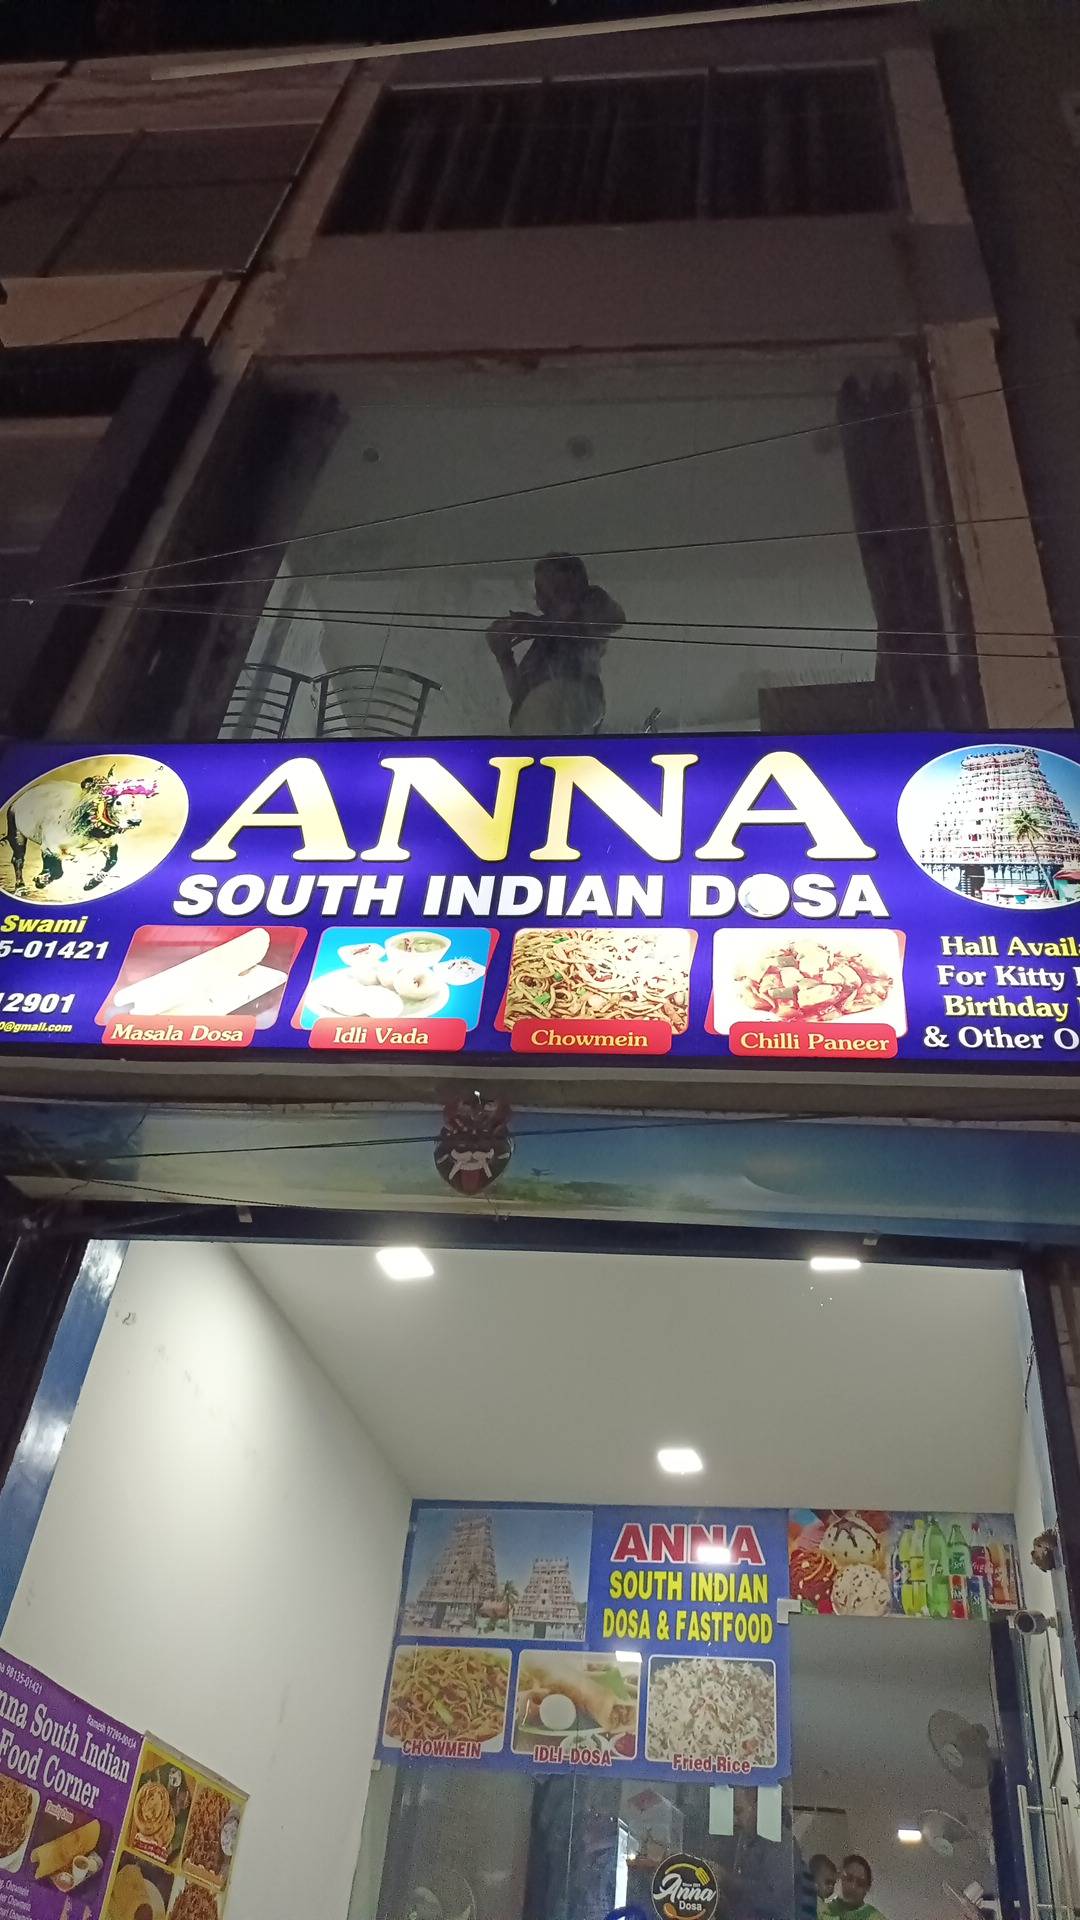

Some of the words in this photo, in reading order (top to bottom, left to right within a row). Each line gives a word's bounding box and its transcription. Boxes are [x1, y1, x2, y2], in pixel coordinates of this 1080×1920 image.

[190, 751, 878, 862] ANNA
[173, 873, 406, 918] SOUTH
[424, 873, 664, 919] INDIAN
[690, 873, 891, 919] DOSA
[0, 915, 88, 933] Swami
[940, 936, 999, 956] Hall
[937, 965, 987, 986] For
[994, 966, 1065, 991] Kitty
[944, 995, 1069, 1022] Birthday
[110, 1024, 184, 1042] Masala
[188, 1025, 244, 1043] Dosa
[333, 1026, 371, 1044] Idli
[374, 1027, 429, 1045] Vada
[530, 1029, 649, 1048] Chowmein
[740, 1032, 800, 1050] Chilli
[808, 1034, 890, 1052] Paneer
[923, 1026, 950, 1048] &
[958, 1026, 1044, 1049] Other
[611, 1522, 766, 1566] ANNA
[609, 1570, 683, 1602] SOUTH
[690, 1572, 769, 1604] INDIAN
[602, 1607, 652, 1640] DOSA
[656, 1611, 670, 1640] &
[675, 1611, 773, 1645] FASTFOOD
[30, 1703, 80, 1758] South
[81, 1731, 131, 1784] Indian
[401, 1738, 482, 1759] CHOWMEIN
[0, 1728, 43, 1781] Food
[43, 1754, 100, 1809] Corner
[672, 1753, 712, 1773] Fried
[716, 1756, 752, 1775] Rice
[653, 1873, 717, 1903] Anna
[679, 1900, 702, 1911] Dosa
